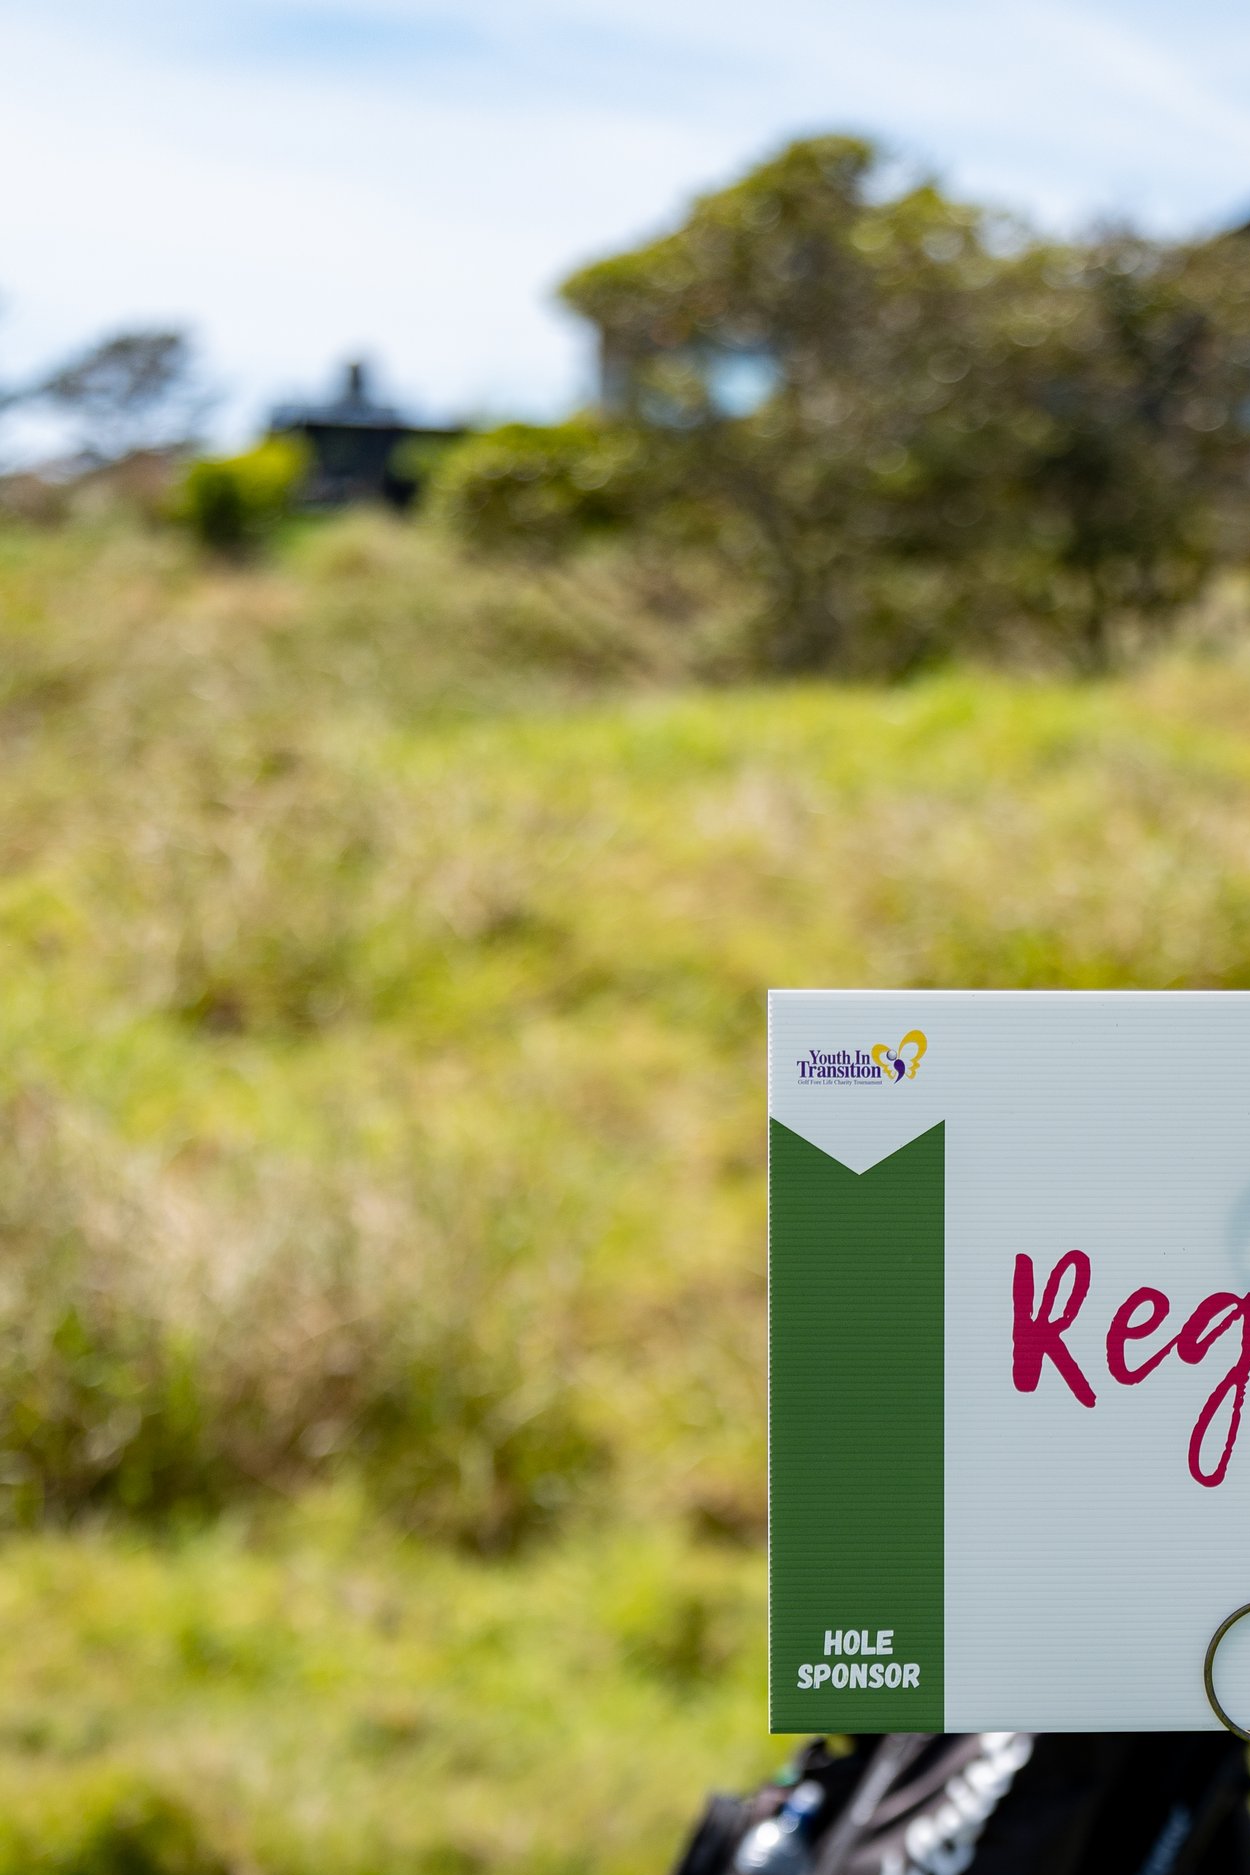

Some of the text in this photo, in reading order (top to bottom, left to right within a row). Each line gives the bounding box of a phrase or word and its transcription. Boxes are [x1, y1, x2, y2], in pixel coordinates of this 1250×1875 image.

[809, 1050, 870, 1065] Youth In
[797, 1061, 882, 1078] Transition
[824, 1630, 894, 1655] HOLE
[797, 1663, 921, 1689] SPONSOR
